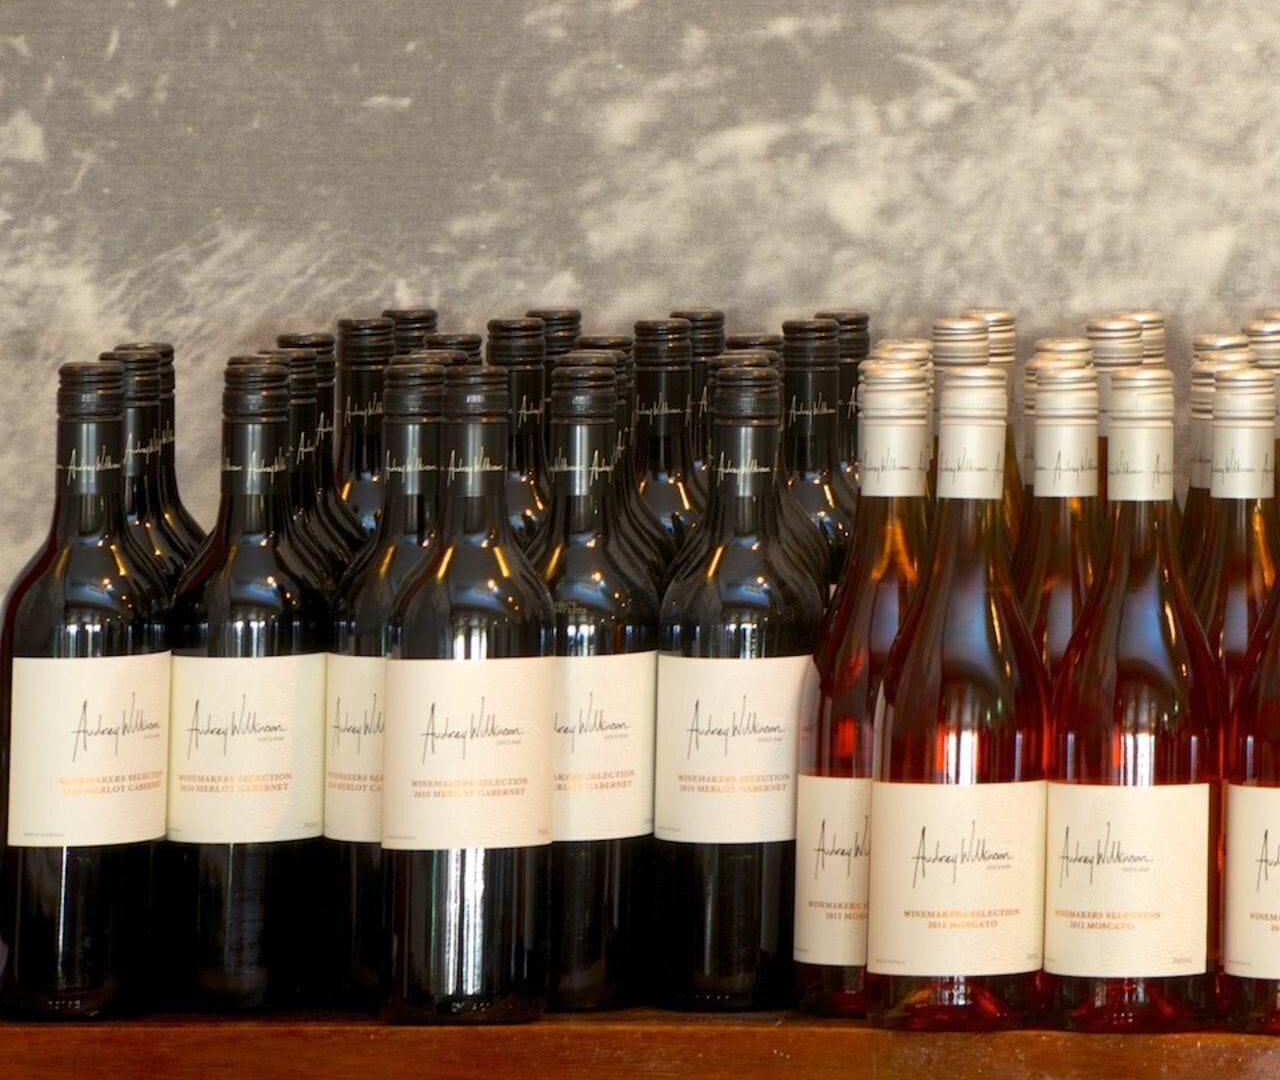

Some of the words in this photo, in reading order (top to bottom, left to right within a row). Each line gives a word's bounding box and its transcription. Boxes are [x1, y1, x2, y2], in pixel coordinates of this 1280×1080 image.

[71, 699, 121, 763] Audrey
[186, 698, 228, 760] Audrey
[231, 692, 288, 737] Wilkinson
[420, 702, 467, 765] Audrey
[470, 696, 524, 740] Wilkinson
[579, 692, 631, 735] Wilkinson
[686, 699, 730, 760] Audrey
[732, 694, 786, 737] Wilkinson
[814, 819, 852, 880] Audrey
[911, 825, 958, 889] Audrey
[961, 820, 1014, 865] Wilkinson
[1059, 825, 1094, 888] Audrey
[1097, 821, 1153, 866] Wilkinson
